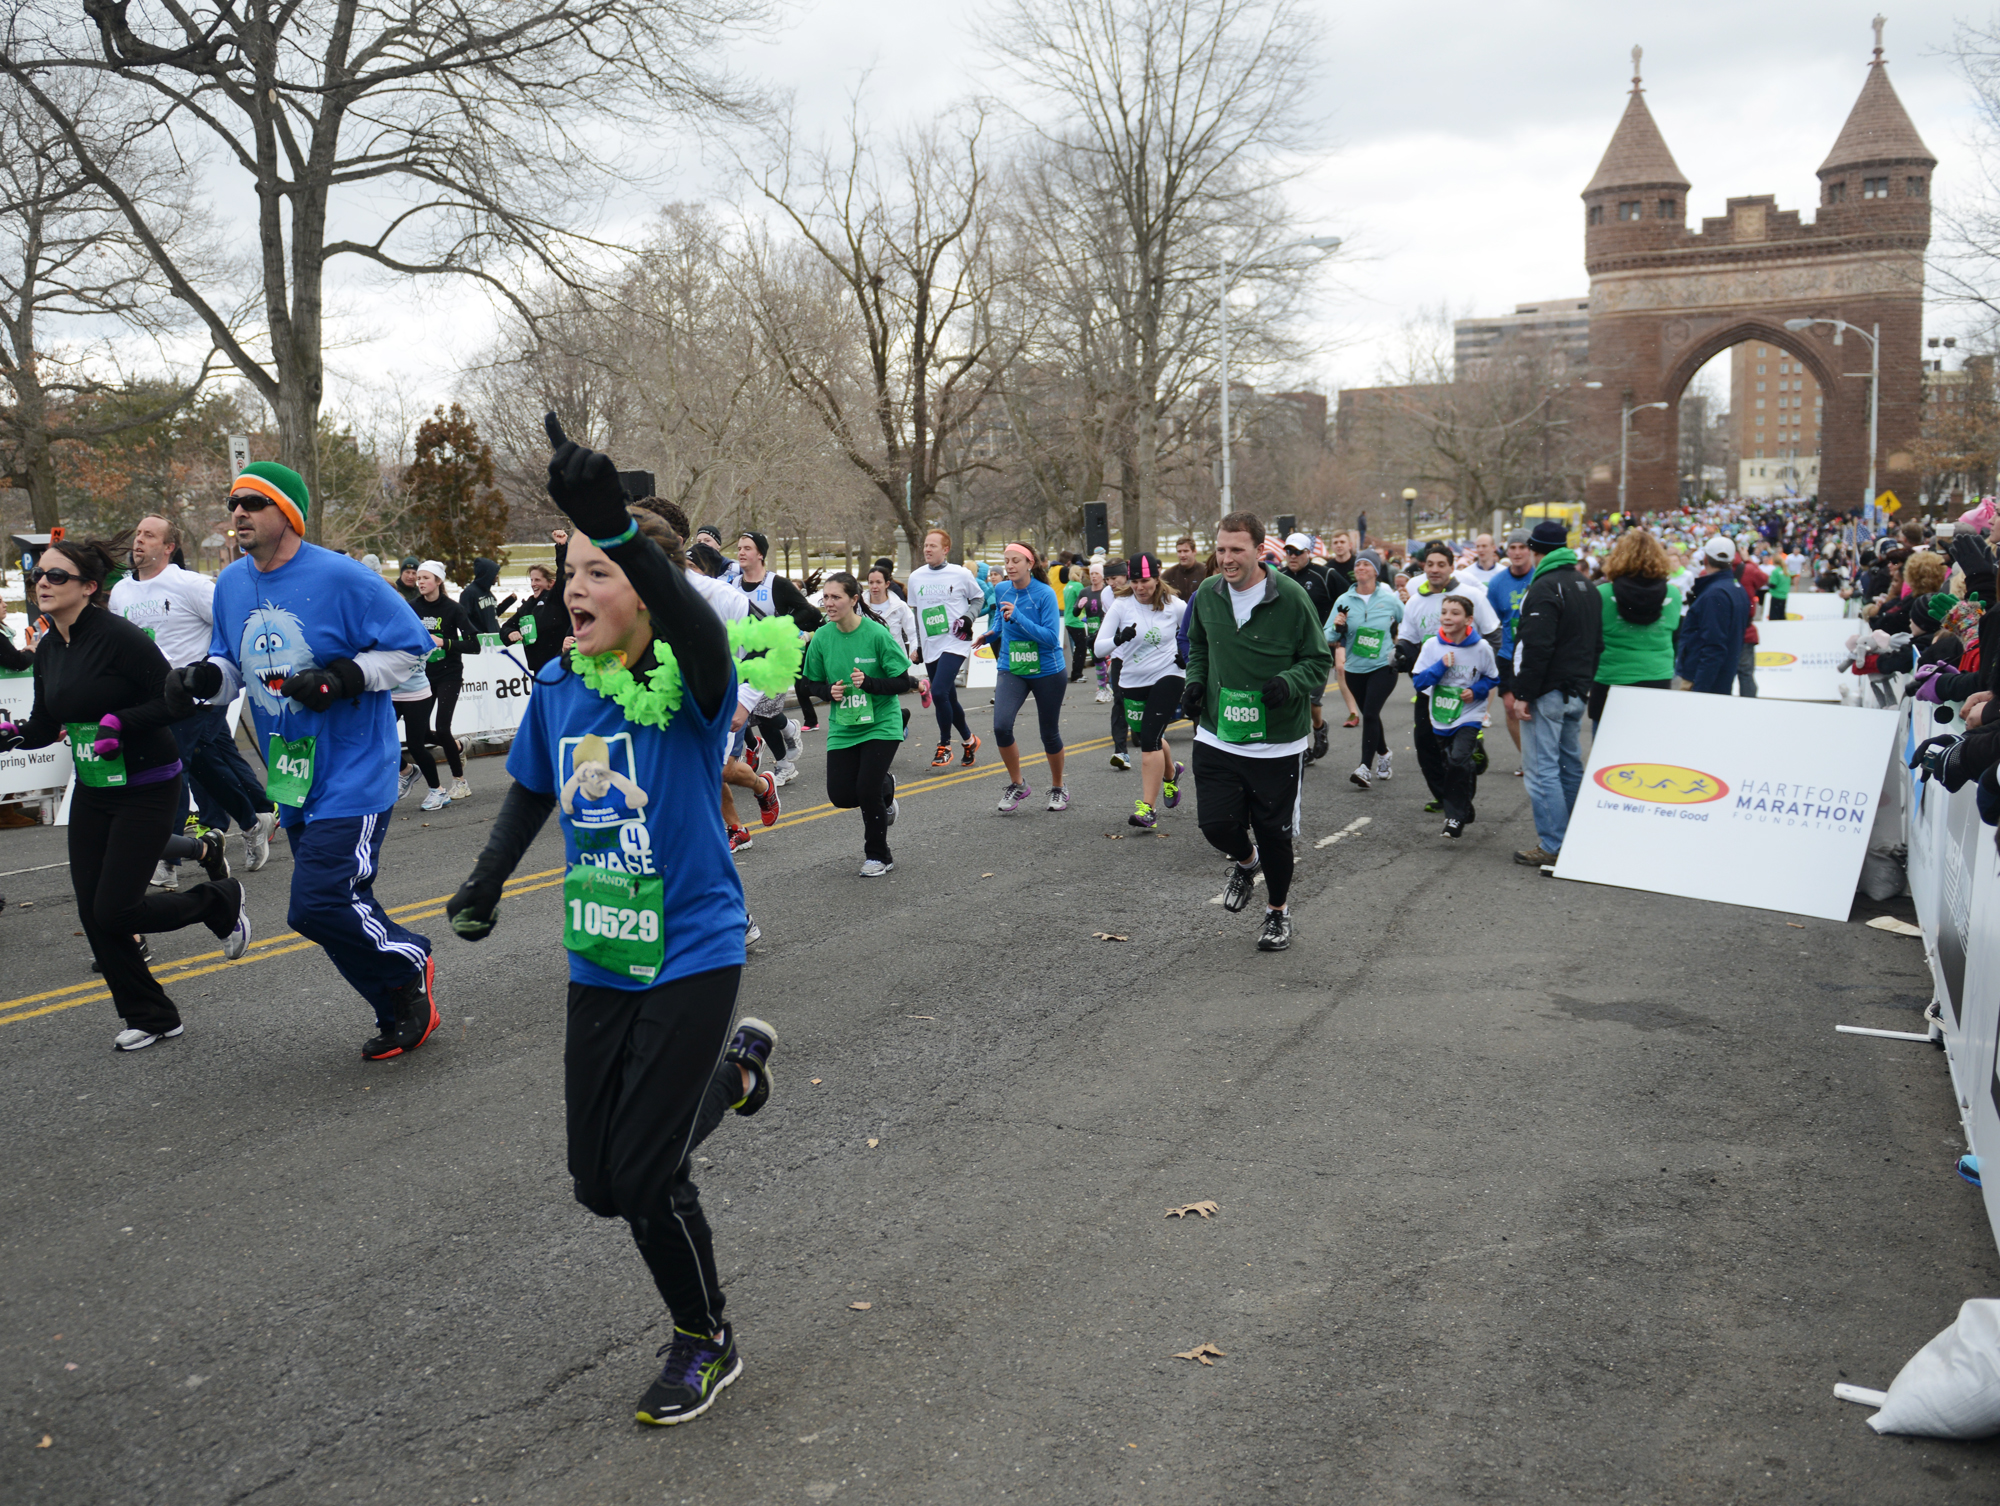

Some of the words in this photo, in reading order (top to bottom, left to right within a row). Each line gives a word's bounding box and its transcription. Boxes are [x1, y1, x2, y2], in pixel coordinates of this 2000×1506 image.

[24, 553, 32, 570] P
[756, 589, 768, 601] 16
[130, 600, 160, 610] SANDY
[131, 607, 159, 618] HOOK
[926, 613, 945, 625] 4203
[1010, 651, 1038, 663] 10496
[840, 694, 867, 709] 2164
[1127, 709, 1144, 721] 237
[1223, 705, 1259, 722] 4939
[76, 742, 101, 762] 447
[0, 756, 26, 771] pring
[28, 753, 56, 764] Water
[1741, 779, 1869, 806] HARTFORD
[1597, 799, 1619, 811] Live
[1622, 803, 1645, 814] Well
[1654, 807, 1677, 818] Feel
[1680, 810, 1709, 822] Good
[1735, 795, 1865, 824] MARATHON
[1732, 811, 1862, 834] FOUNDATION
[626, 828, 642, 851] 4
[580, 849, 657, 876] CHASE
[595, 872, 630, 888] SANDY
[568, 898, 659, 943] 10529
